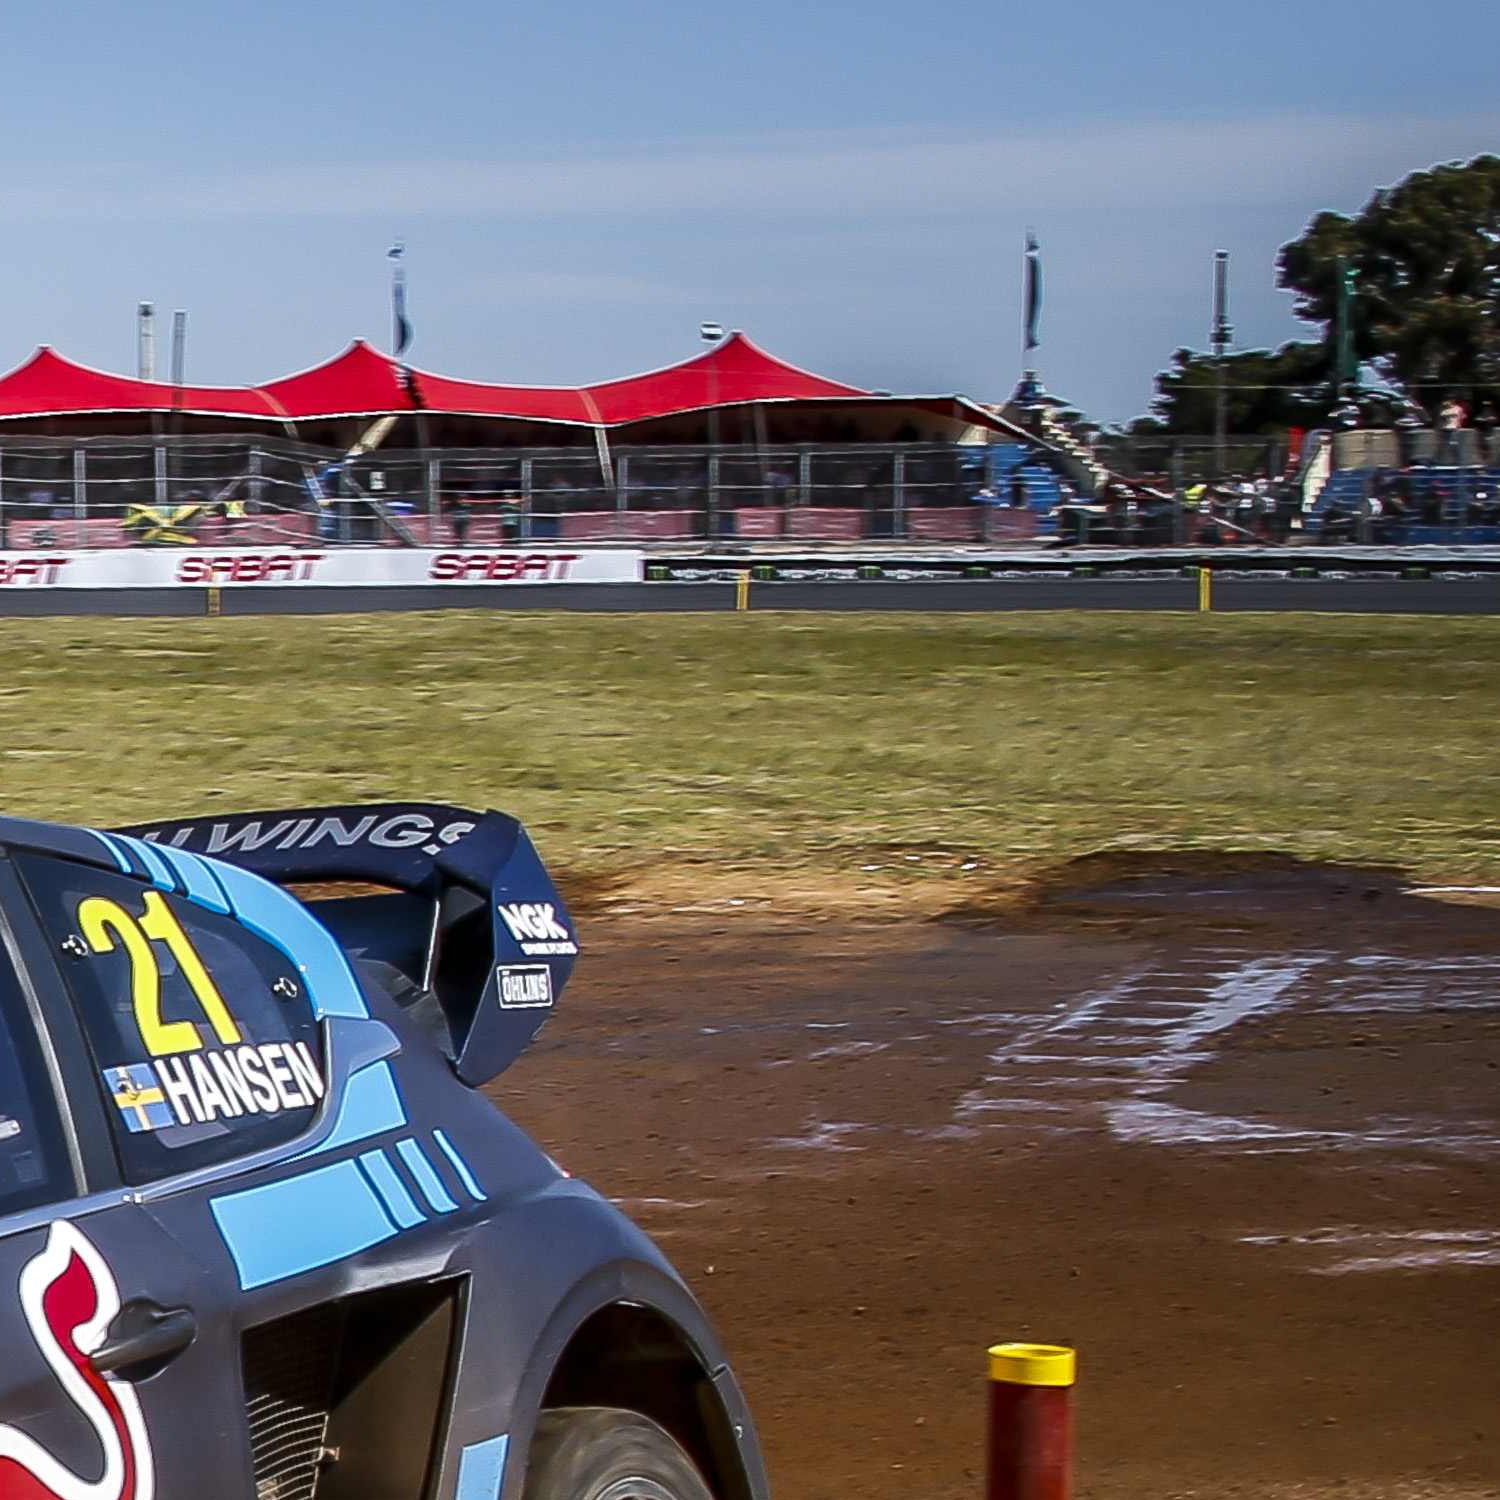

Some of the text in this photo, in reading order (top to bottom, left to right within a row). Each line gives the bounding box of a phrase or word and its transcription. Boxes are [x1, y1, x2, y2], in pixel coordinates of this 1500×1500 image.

[497, 903, 568, 940] NGK
[78, 891, 242, 1056] 21
[154, 1042, 325, 1125] HANSEN
